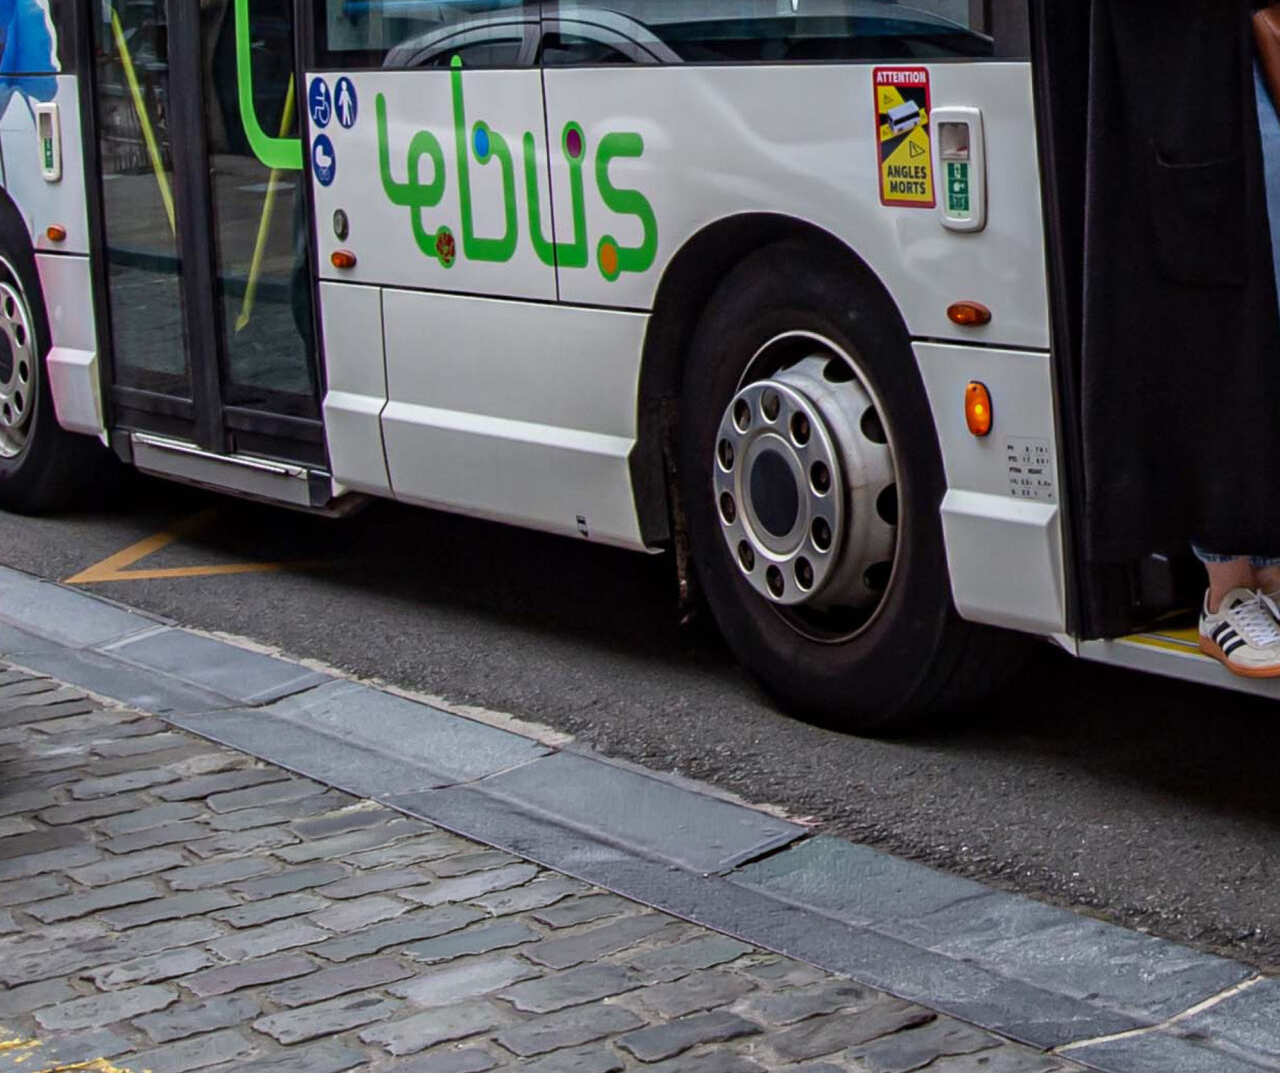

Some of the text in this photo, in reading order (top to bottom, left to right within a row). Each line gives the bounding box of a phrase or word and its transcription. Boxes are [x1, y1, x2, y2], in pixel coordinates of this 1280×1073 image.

[876, 70, 927, 84] ATTENTION
[887, 165, 927, 180] ANGLES
[889, 180, 926, 195] MORTS
